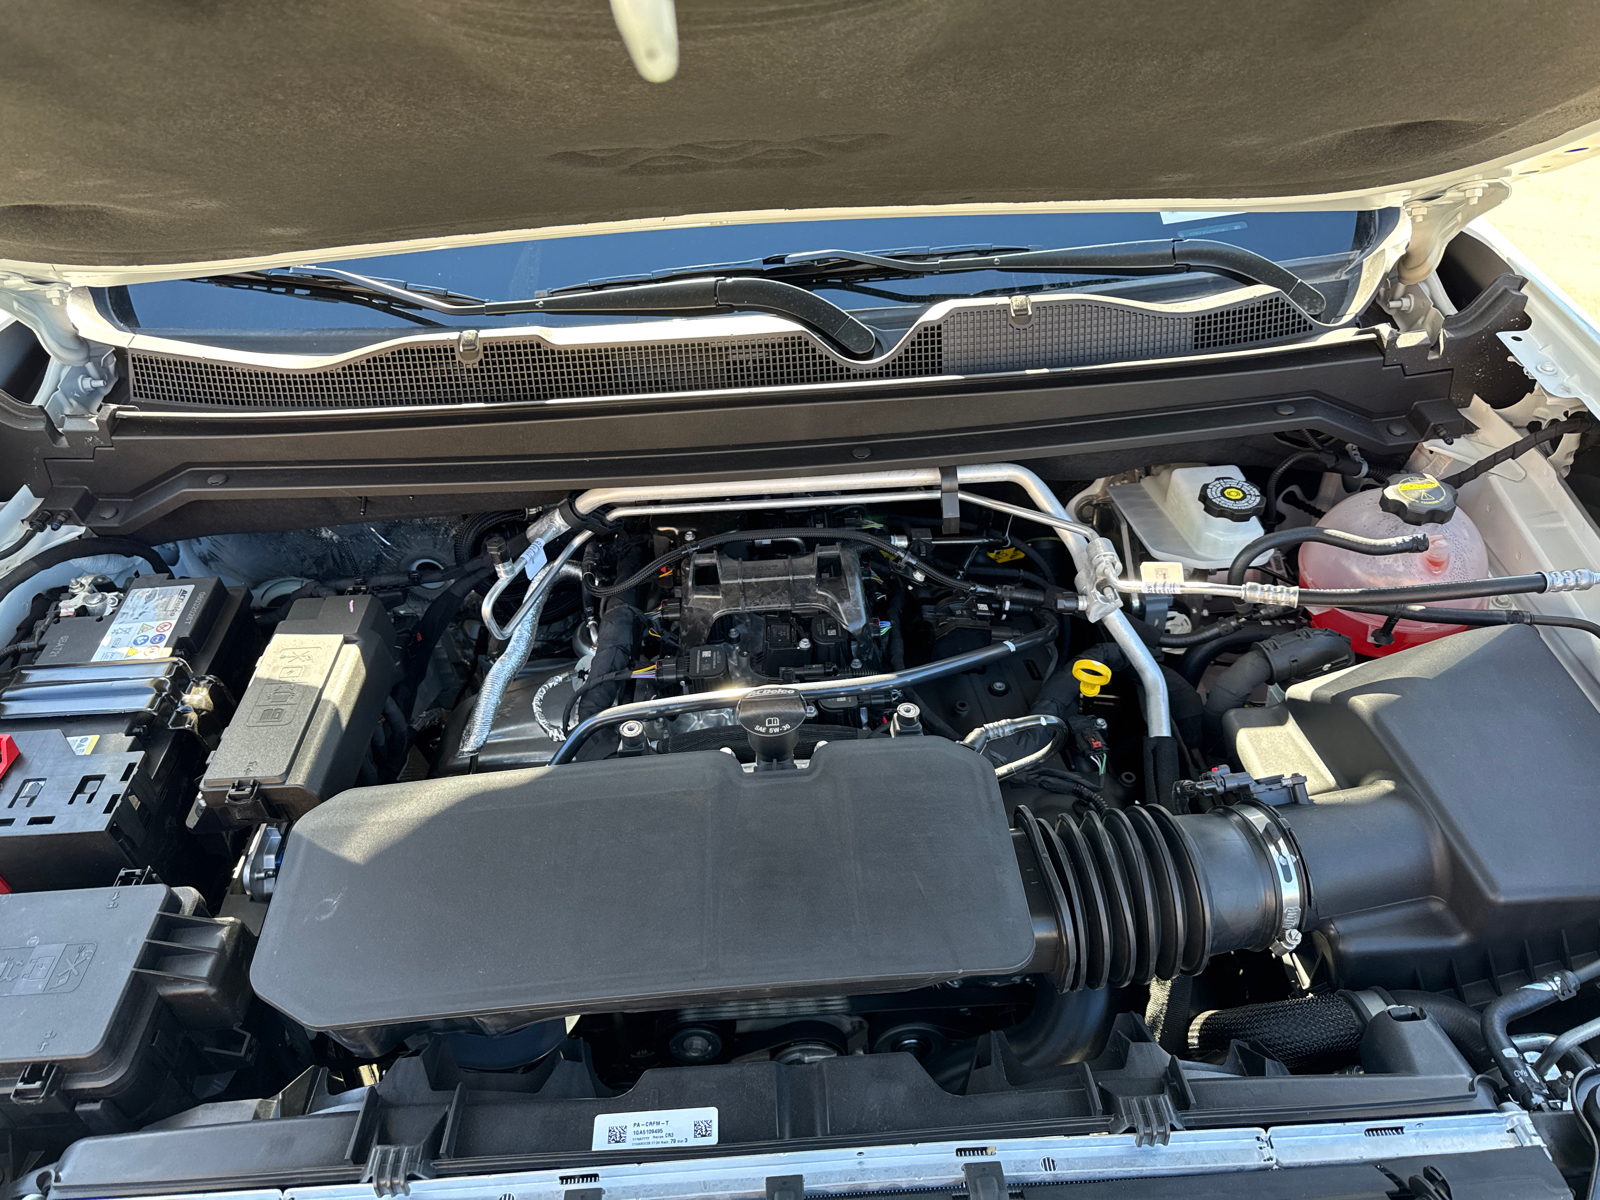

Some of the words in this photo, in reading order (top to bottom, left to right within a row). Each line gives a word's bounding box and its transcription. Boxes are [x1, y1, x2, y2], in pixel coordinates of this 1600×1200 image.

[747, 688, 795, 697] ACDelco
[754, 724, 767, 733] SAE
[769, 723, 791, 734] 5W-30
